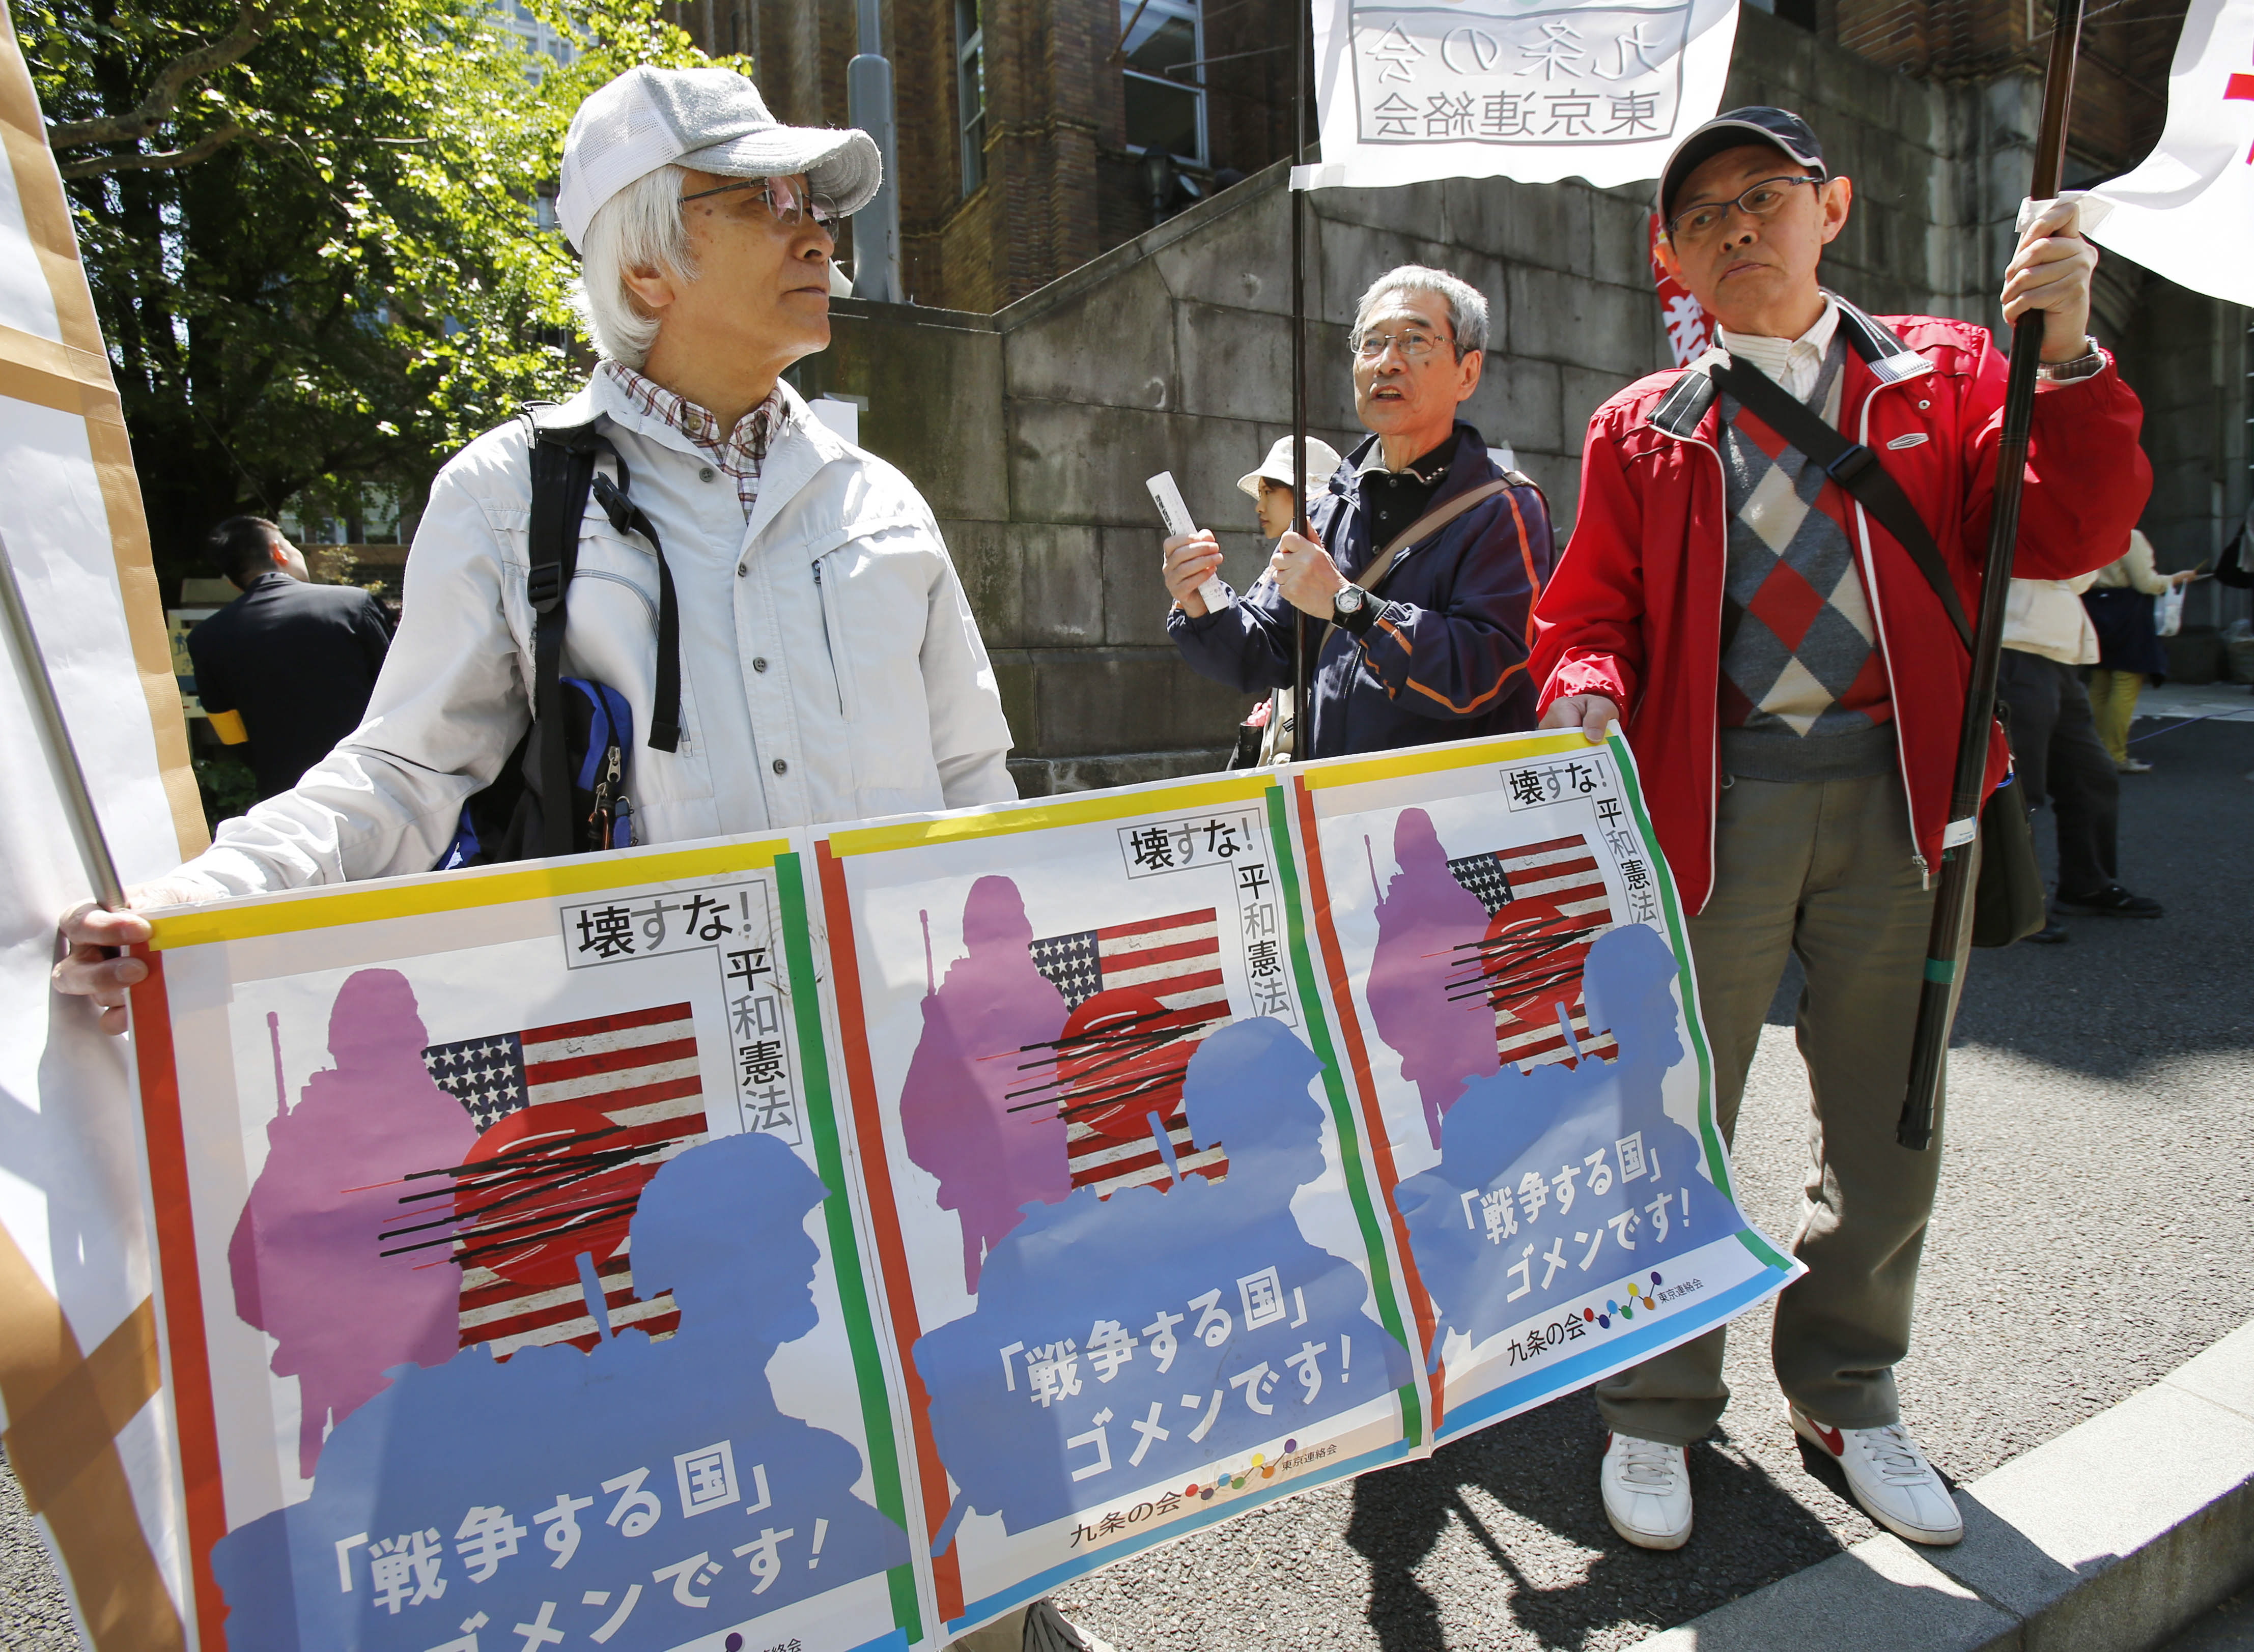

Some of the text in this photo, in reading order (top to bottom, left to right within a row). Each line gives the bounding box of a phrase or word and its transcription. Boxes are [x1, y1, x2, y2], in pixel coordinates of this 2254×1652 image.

[1597, 797, 1657, 924] 平和憲法
[1238, 864, 1290, 1017] 平和憲法
[727, 948, 793, 1132] 平和憲法
[1460, 1131, 1661, 1244] 「戦争する国」
[999, 1265, 1308, 1408] 「戦争する国」
[1507, 1313, 1586, 1366] 九条の会
[1657, 1278, 1704, 1304] 東京連絡会
[1282, 1444, 1337, 1471] 東京連絡会
[335, 1439, 772, 1614] 「戦争する国」
[1070, 1491, 1181, 1548] 九条の会
